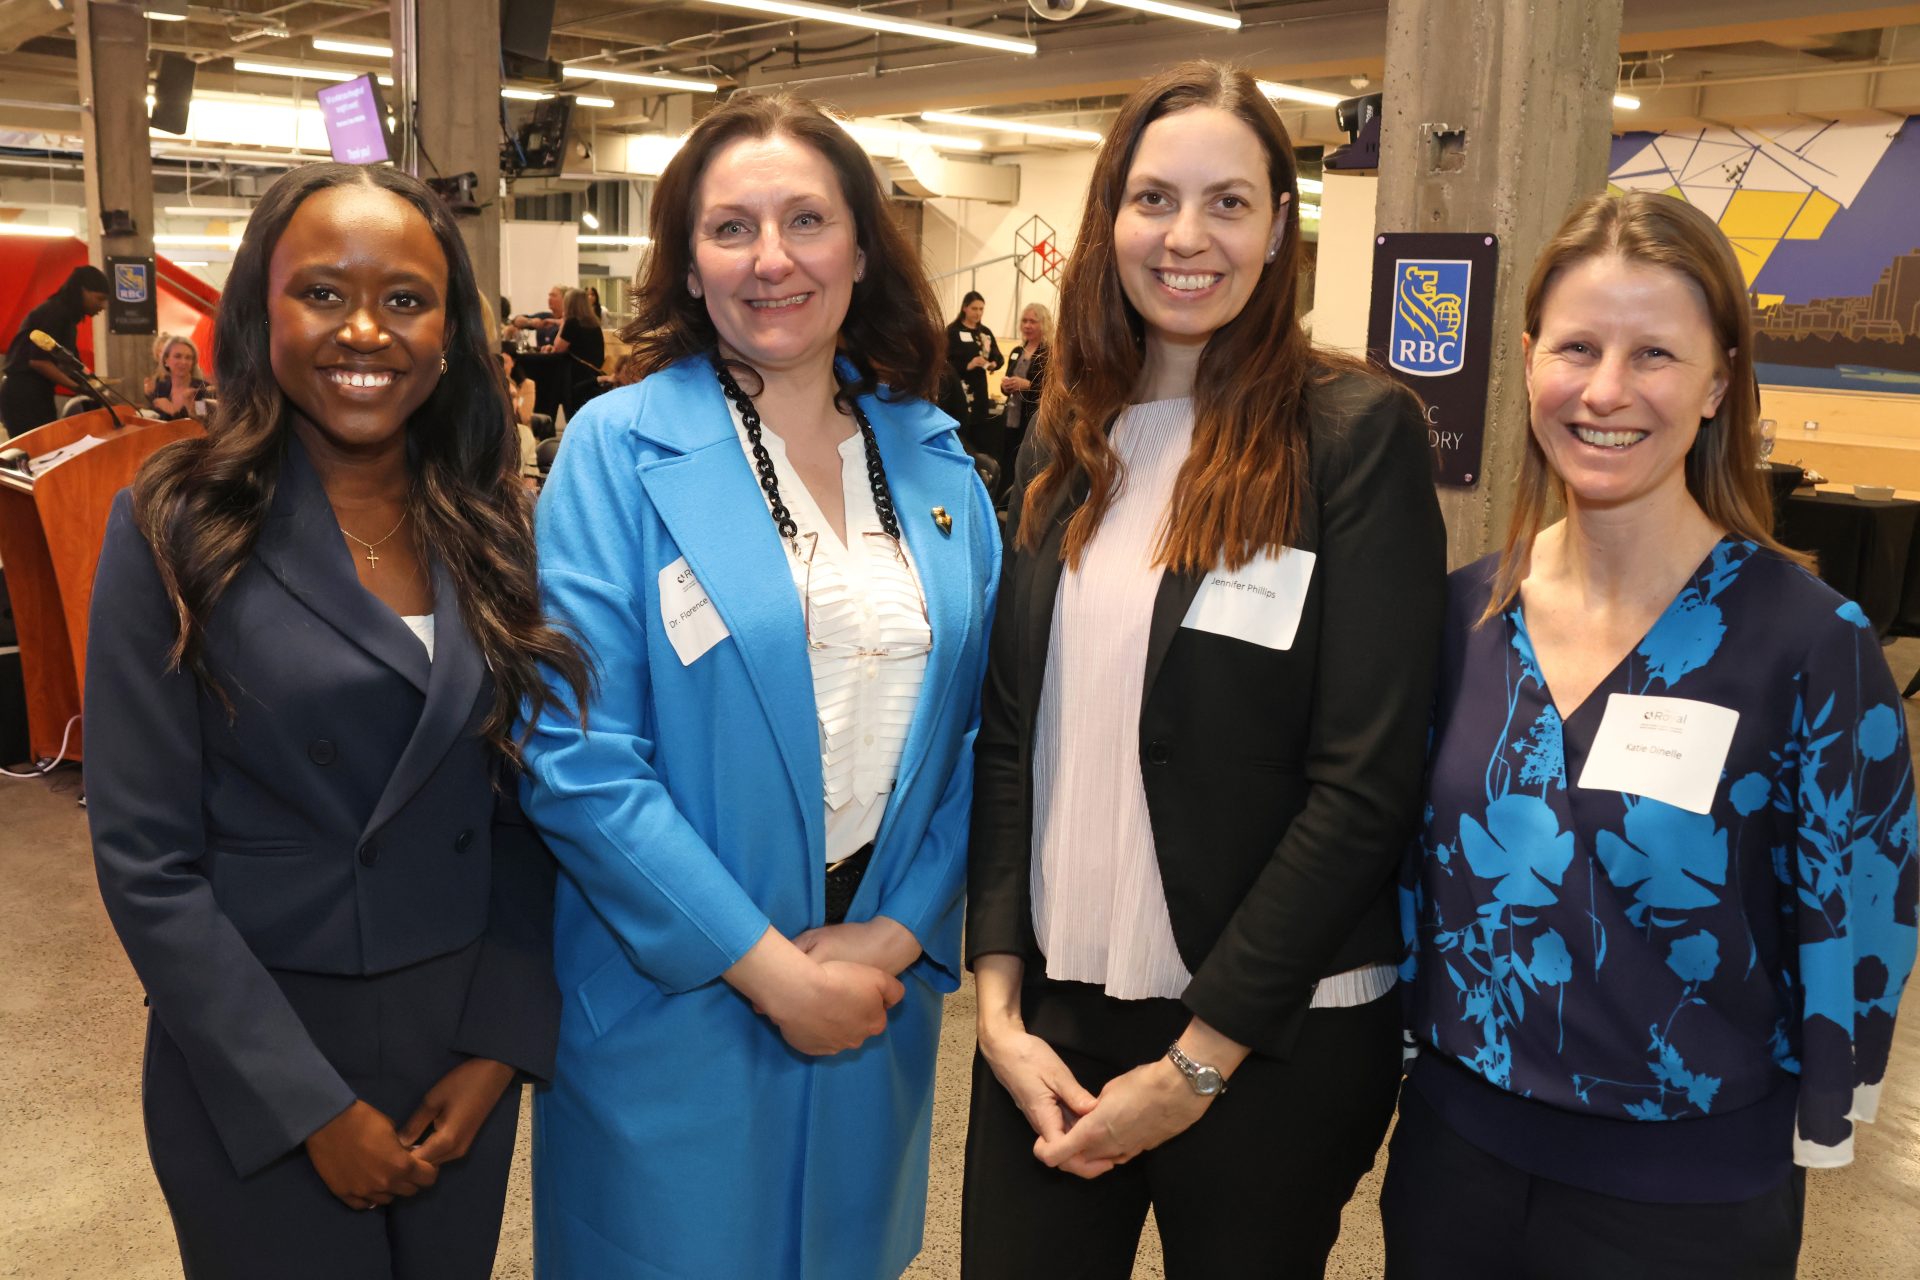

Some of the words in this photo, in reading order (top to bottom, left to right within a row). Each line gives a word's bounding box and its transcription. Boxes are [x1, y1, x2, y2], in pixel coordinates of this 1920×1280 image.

[120, 290, 142, 298] RBC
[1399, 339, 1456, 365] RBC
[1428, 430, 1464, 450] DRY
[1211, 577, 1245, 590] Jennifer
[1247, 583, 1277, 599] Phillips
[669, 618, 681, 629] Dr.
[680, 597, 708, 621] Florence
[1625, 743, 1648, 752] Katie
